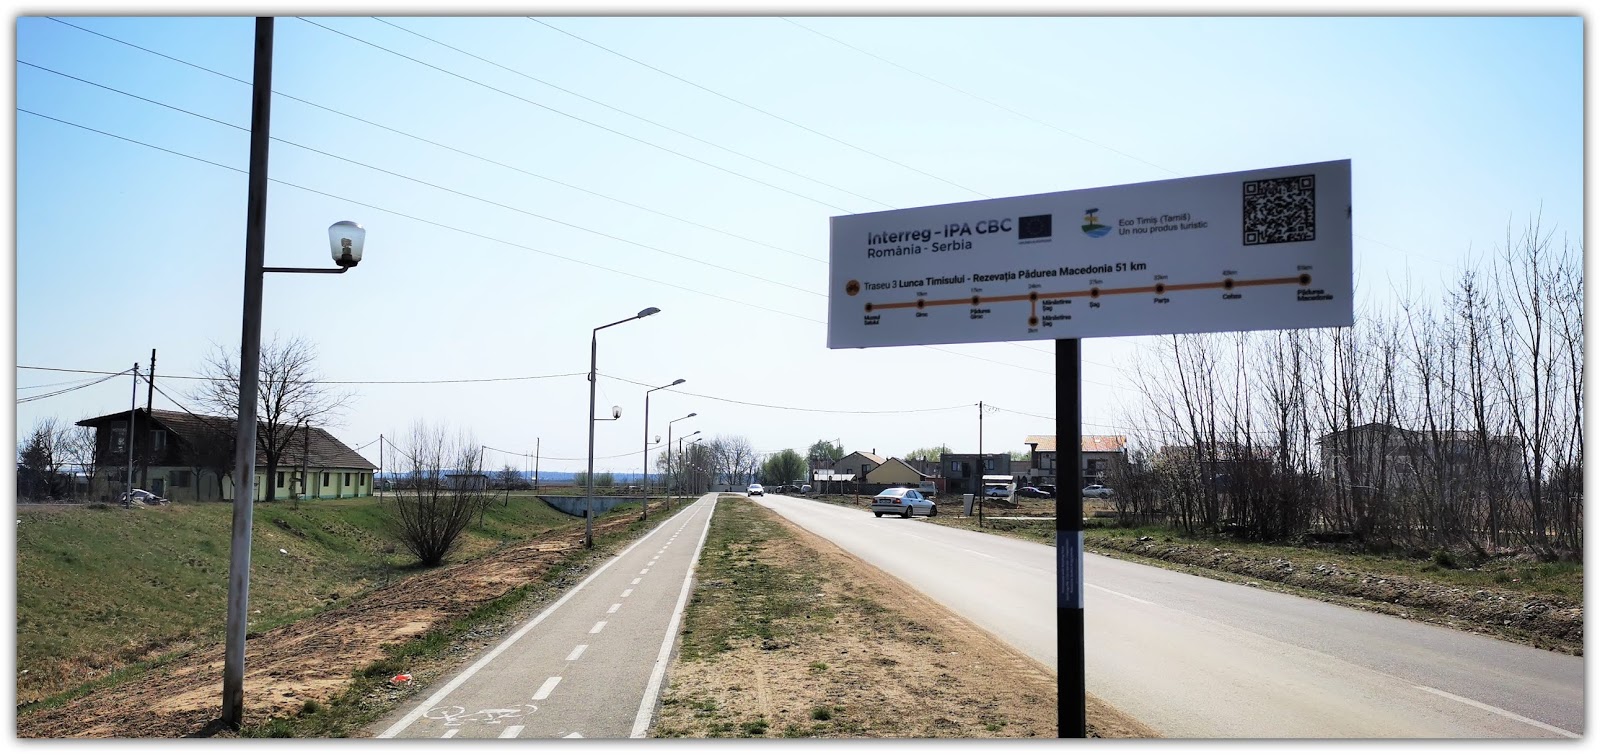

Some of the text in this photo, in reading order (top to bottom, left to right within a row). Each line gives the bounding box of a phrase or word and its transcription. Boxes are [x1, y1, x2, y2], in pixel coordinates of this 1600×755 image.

[868, 229, 931, 246] Interreg
[944, 222, 972, 238] IPA
[975, 218, 1012, 235] CBC
[1118, 219, 1135, 227] Eco
[1118, 227, 1130, 236] Un
[1149, 223, 1178, 234] produs
[1180, 220, 1208, 230] turistic
[867, 243, 921, 259] România
[931, 239, 973, 253] Serbia
[864, 281, 891, 291] Traseu
[892, 280, 897, 289] 3
[899, 279, 924, 288] Lunca
[1018, 269, 1057, 279] Pădurea
[1059, 264, 1113, 276] Macedonia
[1116, 263, 1127, 272] 51
[1130, 261, 1146, 272] km
